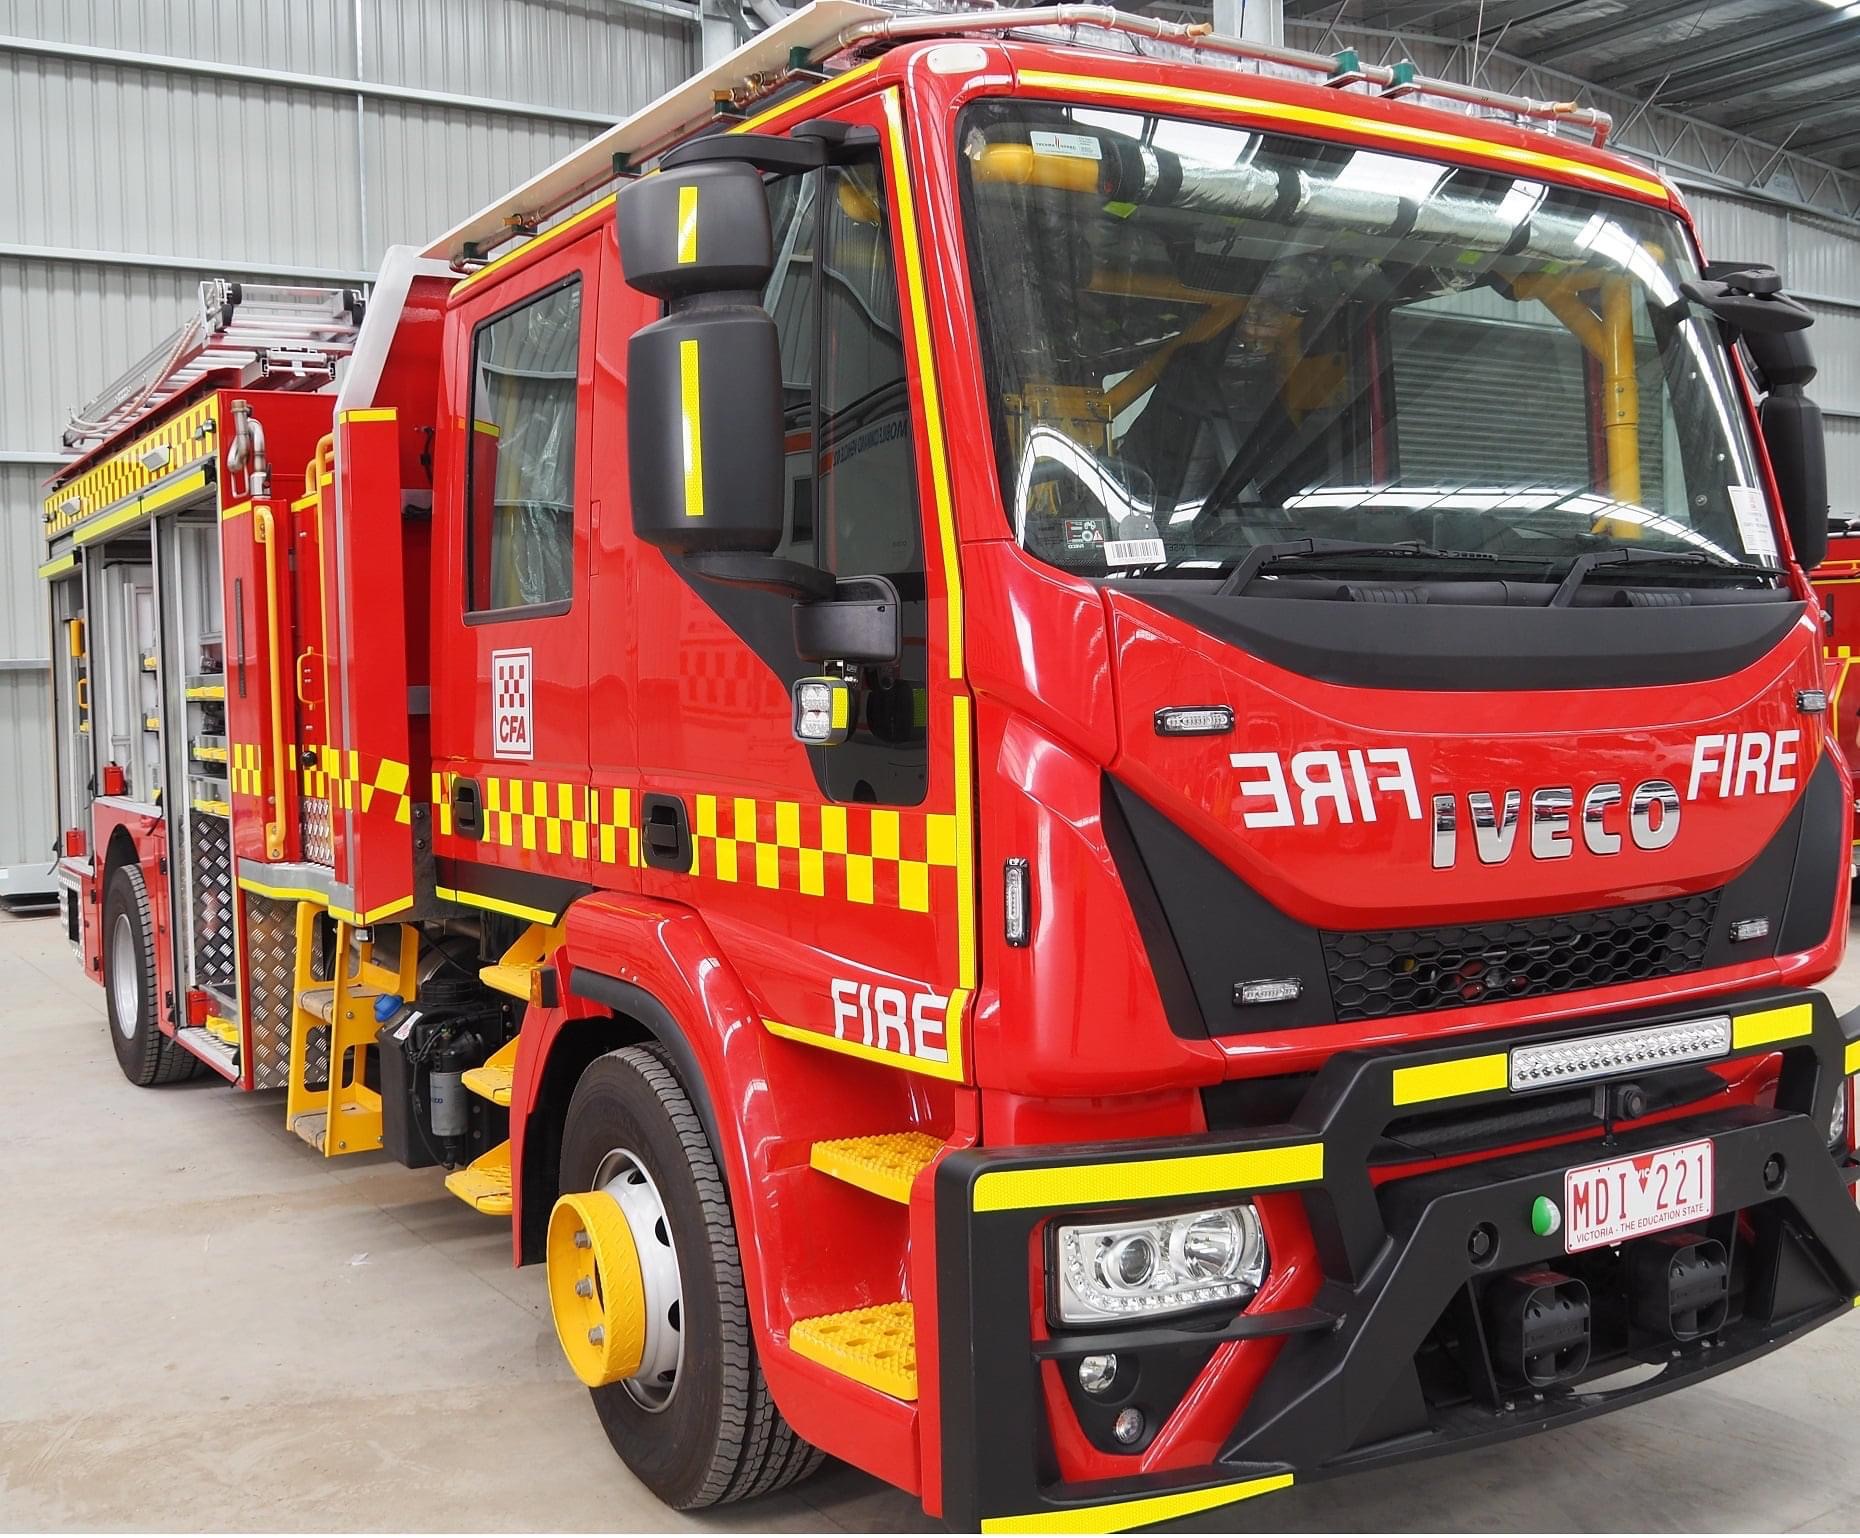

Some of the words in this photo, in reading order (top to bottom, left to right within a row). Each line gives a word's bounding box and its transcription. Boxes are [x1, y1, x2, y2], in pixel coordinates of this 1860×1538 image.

[499, 715, 526, 743] CFA
[1687, 729, 1800, 801] FIRE
[1432, 779, 1681, 870] IVECO
[831, 978, 949, 1063] FIRE
[1573, 1173, 1627, 1232] MDI
[1656, 1154, 1703, 1210] 221
[1577, 1225, 1614, 1243] VICTORIA
[1620, 1220, 1636, 1234] THE
[1637, 1210, 1681, 1229] EDUCATION
[1682, 1203, 1704, 1217] STATE
